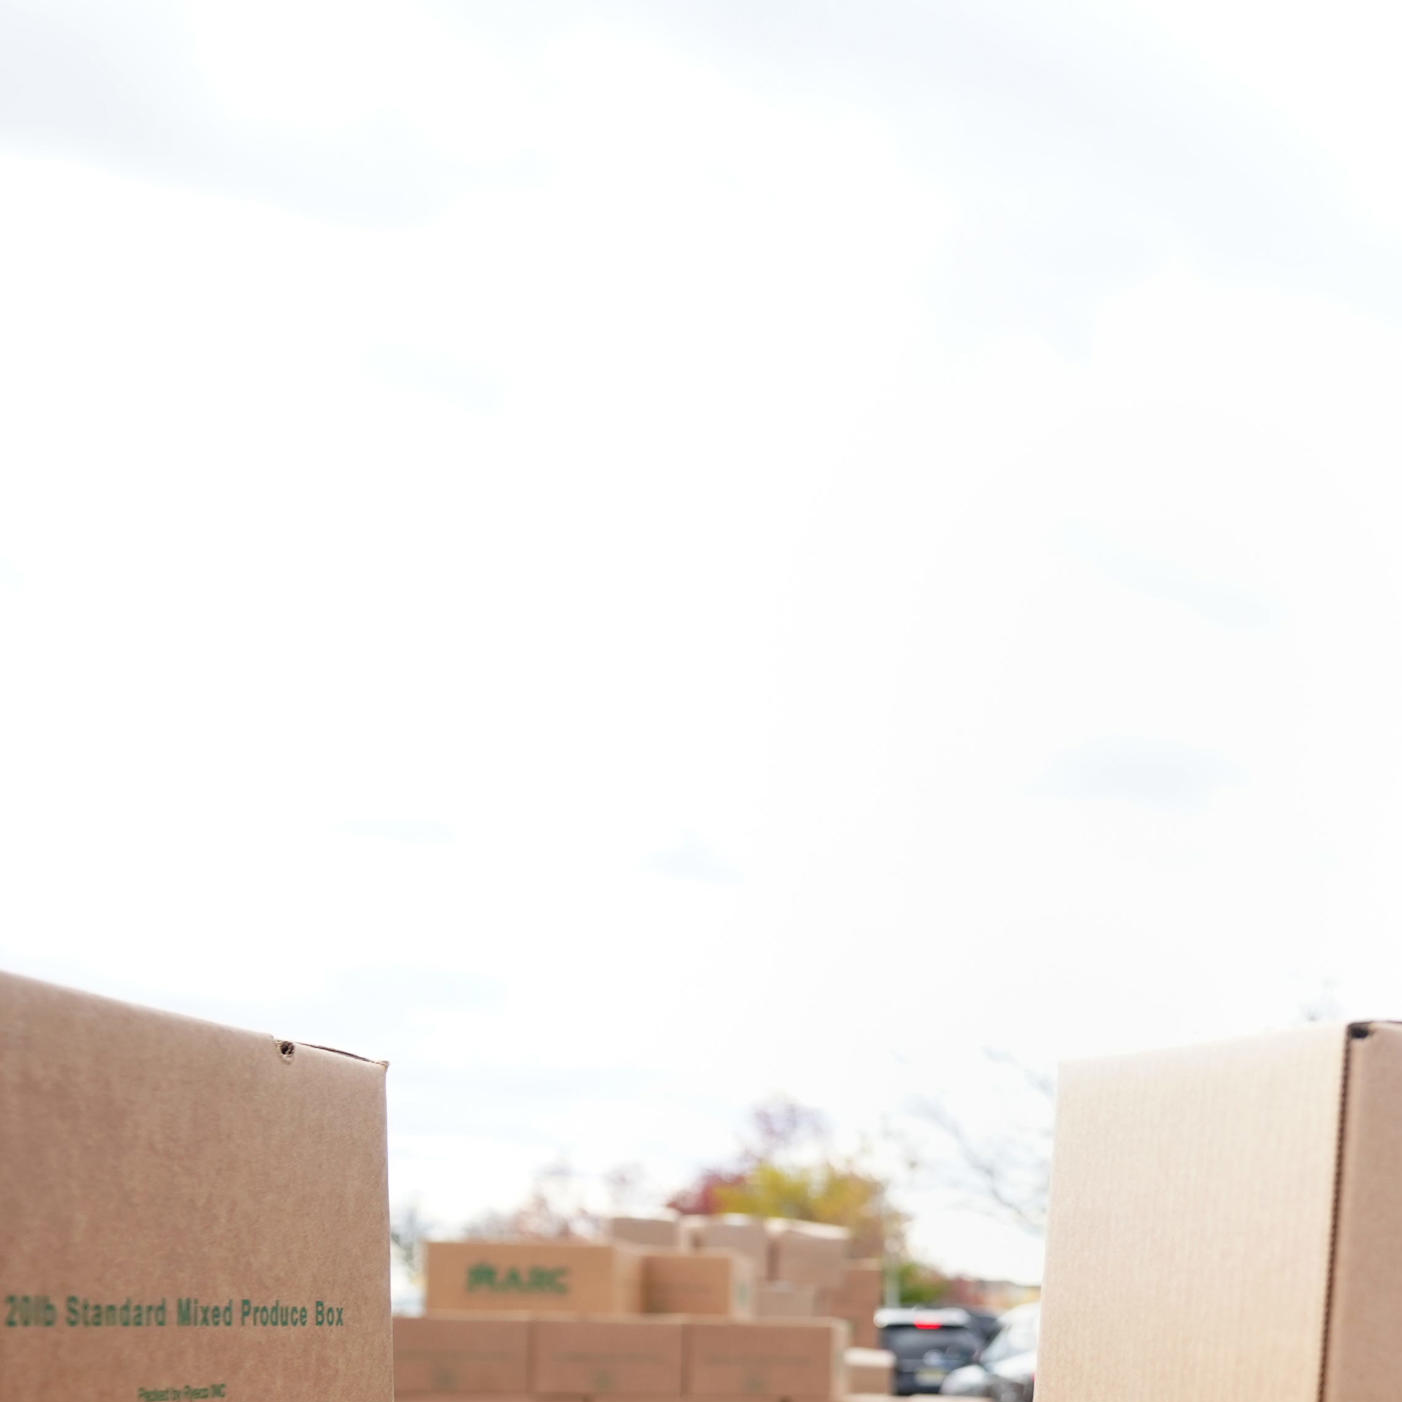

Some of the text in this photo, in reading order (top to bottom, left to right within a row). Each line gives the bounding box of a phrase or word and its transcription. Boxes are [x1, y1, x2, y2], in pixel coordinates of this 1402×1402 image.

[66, 1295, 166, 1326] Standard
[177, 1299, 233, 1326] Mixed
[241, 1299, 308, 1326] Produce
[315, 1301, 344, 1326] Box
